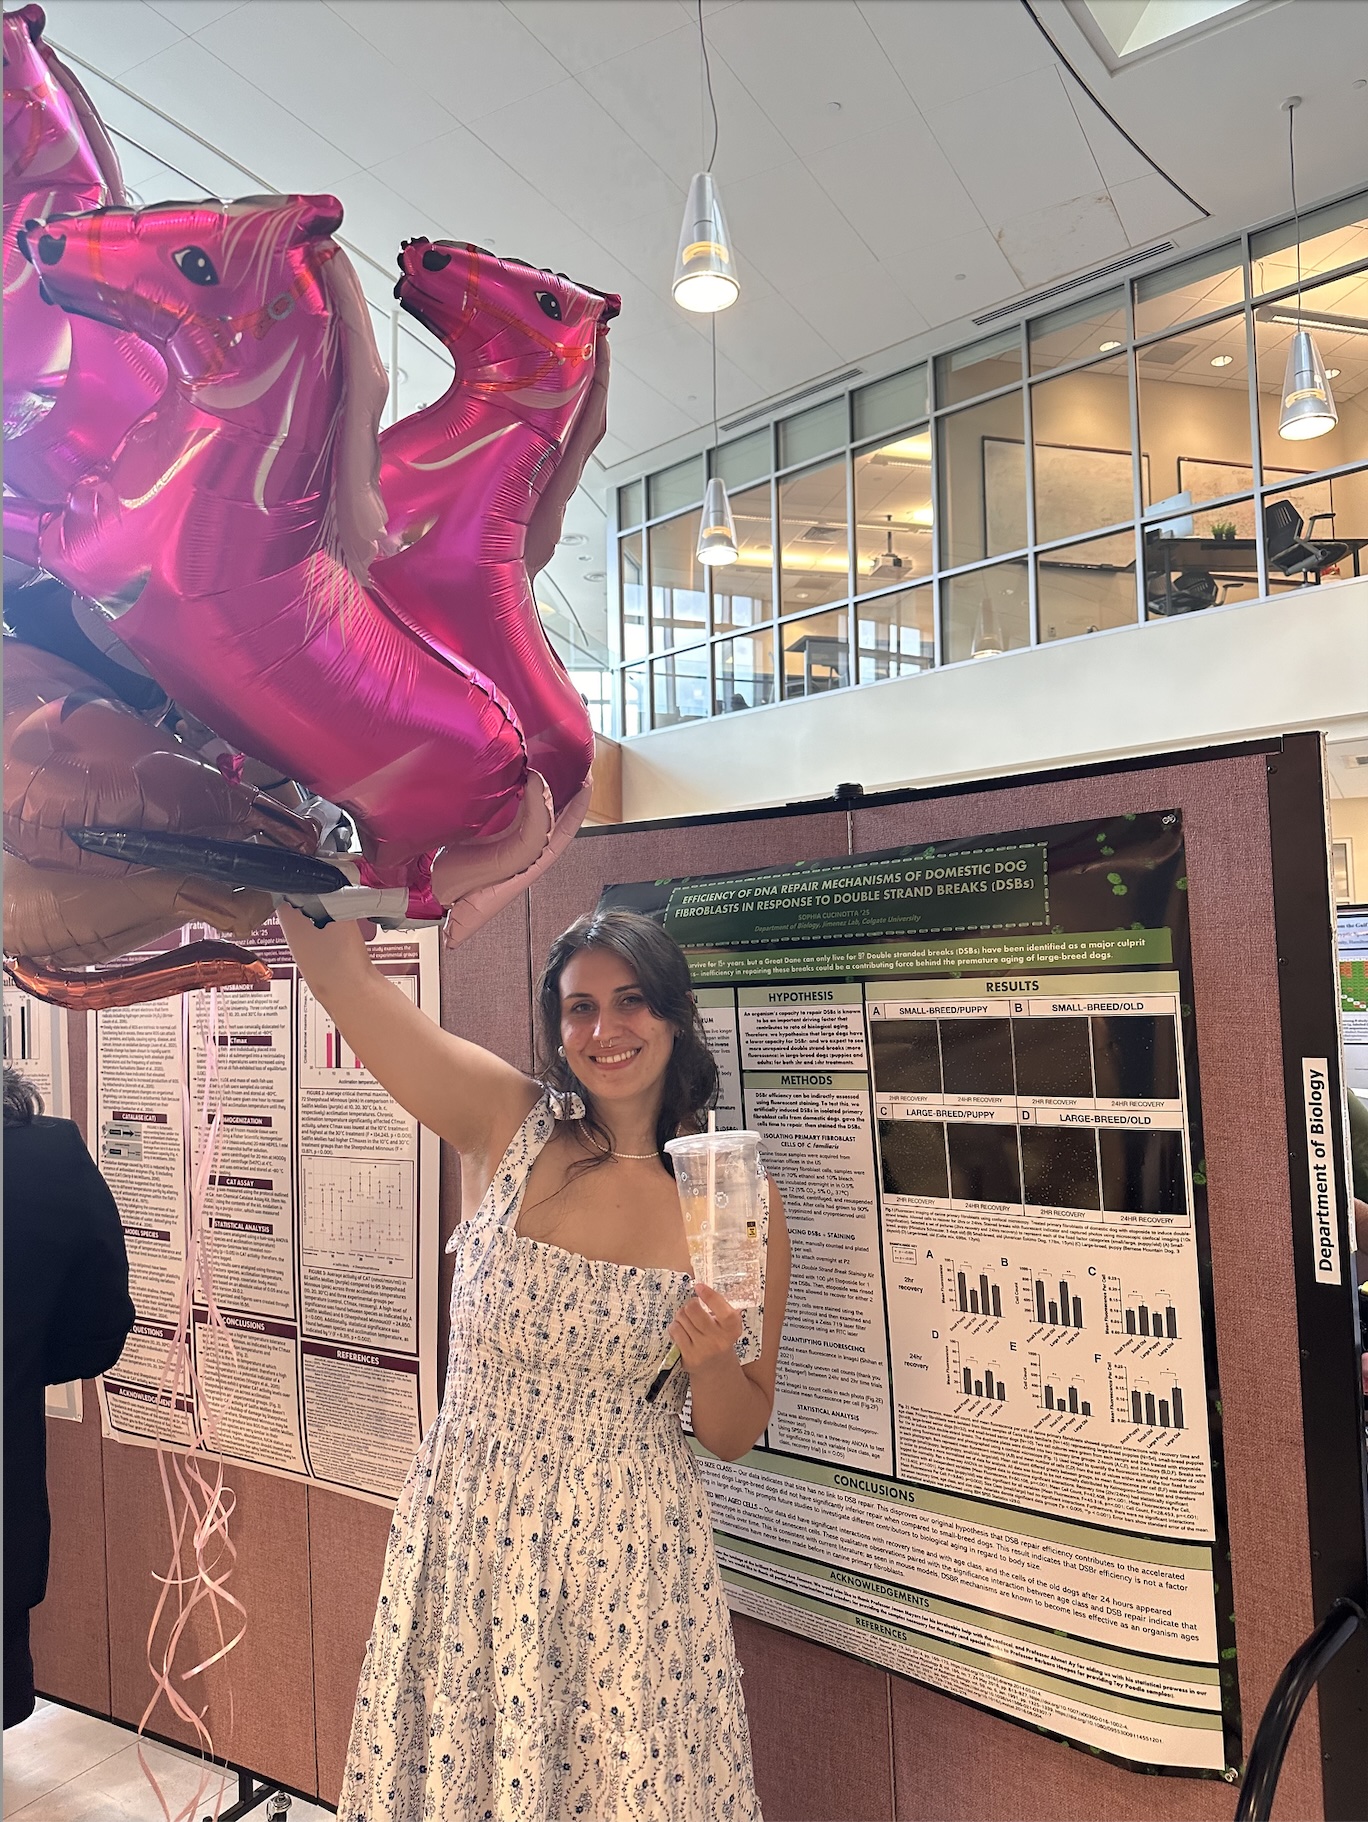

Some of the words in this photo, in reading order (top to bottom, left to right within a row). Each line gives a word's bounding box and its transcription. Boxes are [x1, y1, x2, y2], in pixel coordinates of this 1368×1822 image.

[682, 890, 735, 903] EFFICIENCY
[738, 889, 752, 898] OF
[754, 886, 777, 896] DNA
[780, 881, 818, 893] REPAIR
[821, 873, 901, 889] MECHANISMS
[904, 871, 921, 881] OF
[925, 864, 990, 879] DOMESTIC
[994, 860, 1027, 873] DOG
[674, 903, 739, 917] FIBROBLASTS
[742, 902, 754, 911] IN
[756, 896, 812, 910] RESPONSE
[815, 894, 830, 905] TO
[834, 890, 879, 903] DOUBLE
[883, 886, 932, 899] STRAND
[936, 881, 987, 895] BREAKS
[992, 877, 1034, 891] (DSBs)
[798, 912, 820, 920] SOPHIA
[822, 910, 858, 918] CUCINOTTA
[754, 923, 789, 932] Department
[822, 919, 846, 927] Jimenez
[861, 917, 886, 925] Colgate
[888, 914, 921, 923] University
[815, 955, 830, 963] only
[866, 951, 891, 959] Double
[927, 948, 954, 956] breaks
[955, 947, 980, 955] (DSBs)
[1026, 942, 1065, 951] identified
[1089, 940, 1115, 950] major
[1117, 938, 1146, 948] culprit
[700, 969, 733, 977] inefficiency
[742, 968, 771, 976] repairing
[852, 961, 894, 970] contributing
[915, 958, 941, 966] behind
[943, 957, 956, 965] the
[957, 957, 998, 966] premature
[1000, 955, 1024, 964] aging
[1037, 951, 1087, 962] large-breed
[1089, 950, 1114, 960] dogs.
[986, 981, 1039, 991] RESULTS
[768, 991, 833, 1001] HYPOTHESIS
[873, 1007, 880, 1015] A
[899, 1006, 988, 1014] SMALL-BREED/PUPPY
[1015, 1003, 1023, 1012] B
[1052, 1002, 1143, 1011] SMALL-BREED/OLD
[781, 1075, 832, 1084] METHODS
[1309, 1069, 1325, 1135] Biology
[880, 1106, 888, 1116] C
[906, 1109, 994, 1118] LARGE-BREED/PUPPY
[1022, 1110, 1030, 1120] D
[1060, 1114, 1151, 1124] LARGE-BREED/OLD
[1311, 1140, 1326, 1158] of
[1314, 1163, 1334, 1272] Department
[214, 1220, 243, 1229] STATISTICAL
[244, 1224, 269, 1232] ANALYSIS
[140, 1230, 158, 1238] SPECIES
[827, 1232, 855, 1240] STAINING
[926, 1250, 934, 1259] A
[1001, 1258, 1009, 1267] B
[1088, 1267, 1096, 1276] C
[898, 1285, 923, 1294] recovery
[222, 1316, 264, 1330] CONCLUSIONS
[132, 1325, 163, 1337] QUESTIONS
[932, 1330, 939, 1339] D
[782, 1335, 822, 1346] QUANTIFYING
[823, 1341, 865, 1352] FLUORESCENCE
[1010, 1342, 1017, 1351] E
[336, 1350, 379, 1364] REFERENCES
[1095, 1354, 1102, 1363] F
[904, 1361, 928, 1371] recovery
[797, 1405, 830, 1415] STATISTICAL
[831, 1411, 859, 1420] ANALYSIS
[834, 1474, 914, 1502] CONCLUSIONS
[955, 1524, 988, 1539] hypothesis
[990, 1532, 1003, 1540] that
[1005, 1536, 1019, 1544] DSB
[1020, 1540, 1040, 1552] repair
[1042, 1545, 1072, 1559] efficiency
[1074, 1553, 1114, 1567] contributes
[1127, 1564, 1139, 1572] the
[1141, 1567, 1184, 1580] accelerated
[830, 1571, 929, 1607] ACKNOWLEDGEMENTS
[1081, 1591, 1097, 1600] after
[1100, 1595, 1110, 1603] 24
[1112, 1598, 1133, 1609] hours
[1136, 1603, 1171, 1617] appeared
[855, 1617, 907, 1640] REFERENCES
